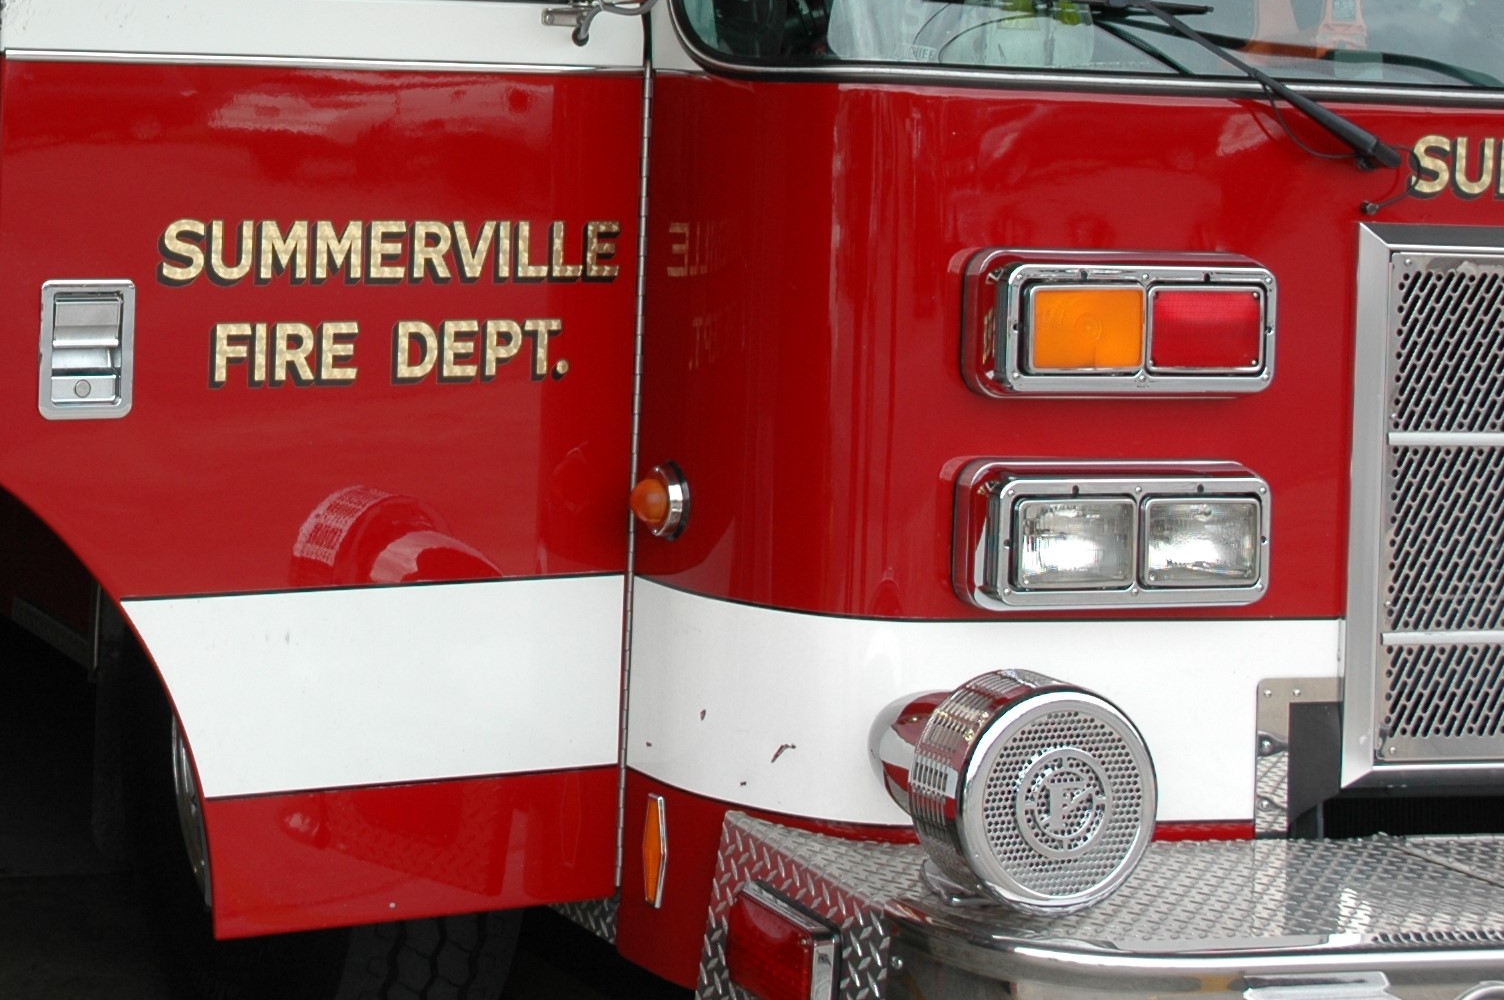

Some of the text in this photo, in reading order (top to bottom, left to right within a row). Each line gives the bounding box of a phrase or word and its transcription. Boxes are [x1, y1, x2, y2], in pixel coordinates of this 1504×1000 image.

[1405, 134, 1503, 200] SU
[157, 218, 620, 288] SUMMERVILLE
[208, 318, 569, 390] FIRE DEPT.
